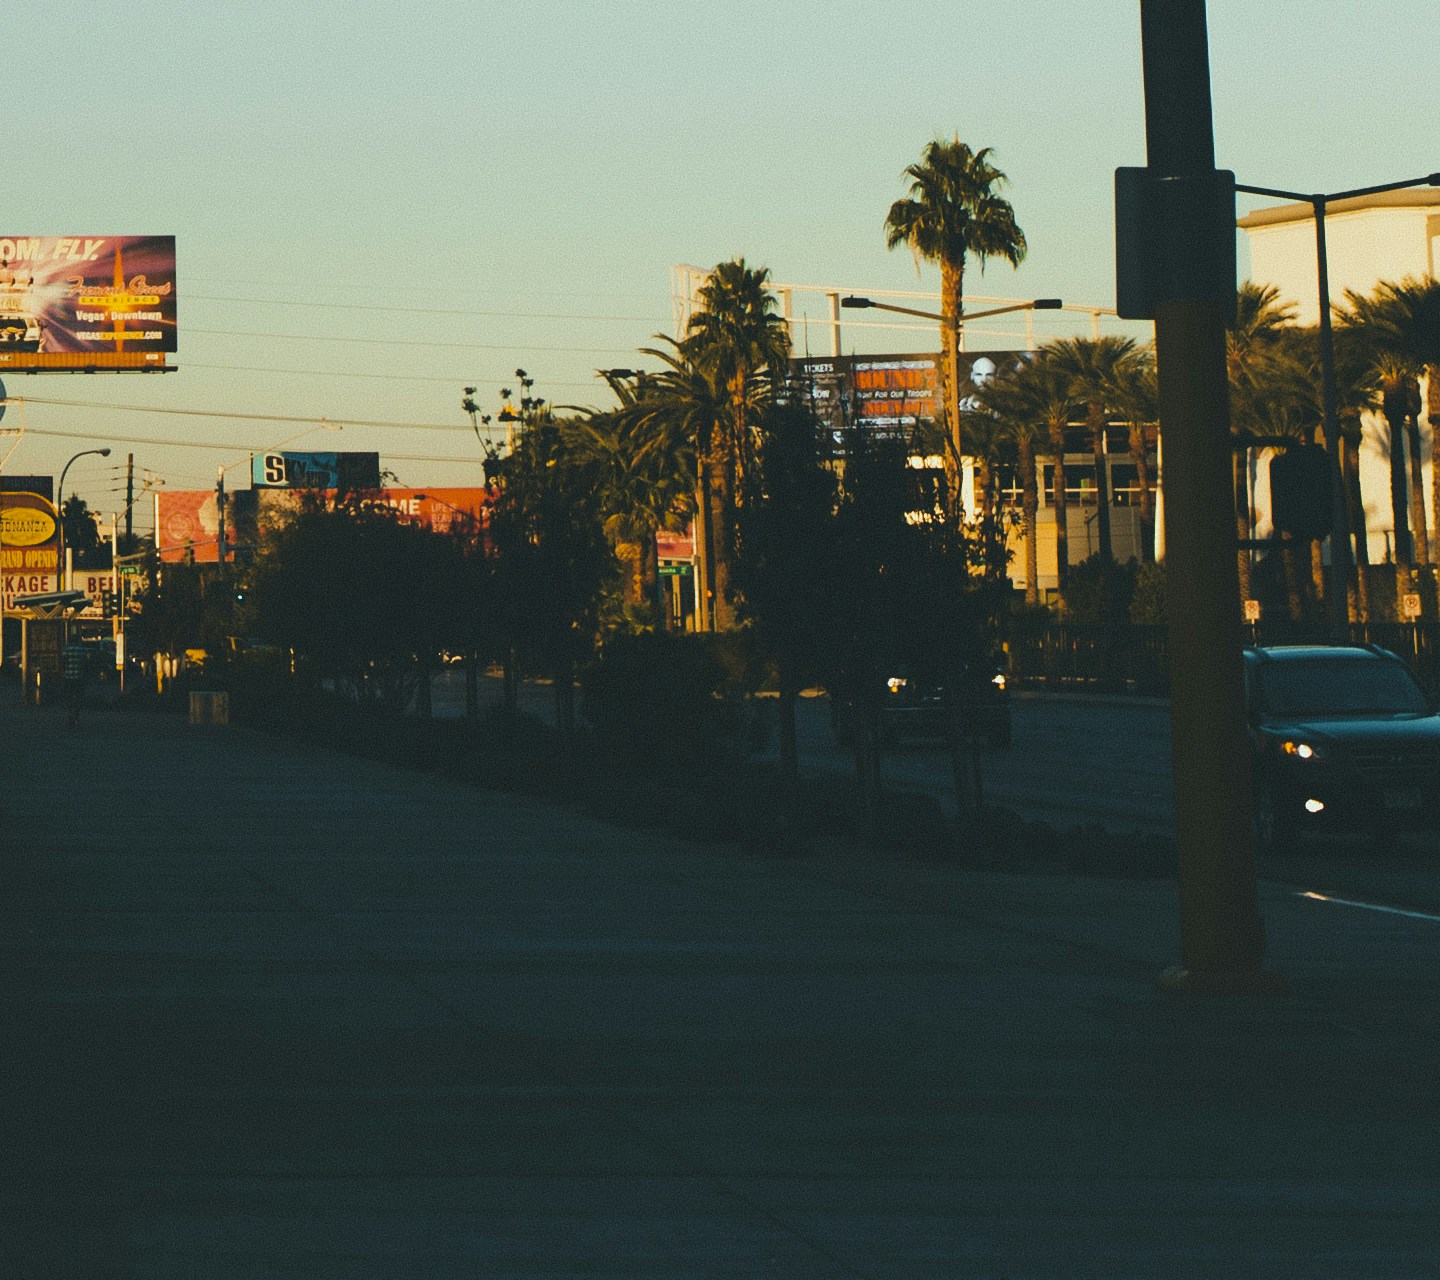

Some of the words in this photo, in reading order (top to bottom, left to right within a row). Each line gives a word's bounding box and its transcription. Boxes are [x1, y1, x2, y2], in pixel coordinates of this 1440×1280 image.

[51, 239, 105, 261] FLY.
[111, 310, 162, 321] Downtown
[0, 550, 23, 569] RAND
[25, 549, 58, 569] OPENIN
[1, 576, 49, 592] KAGE
